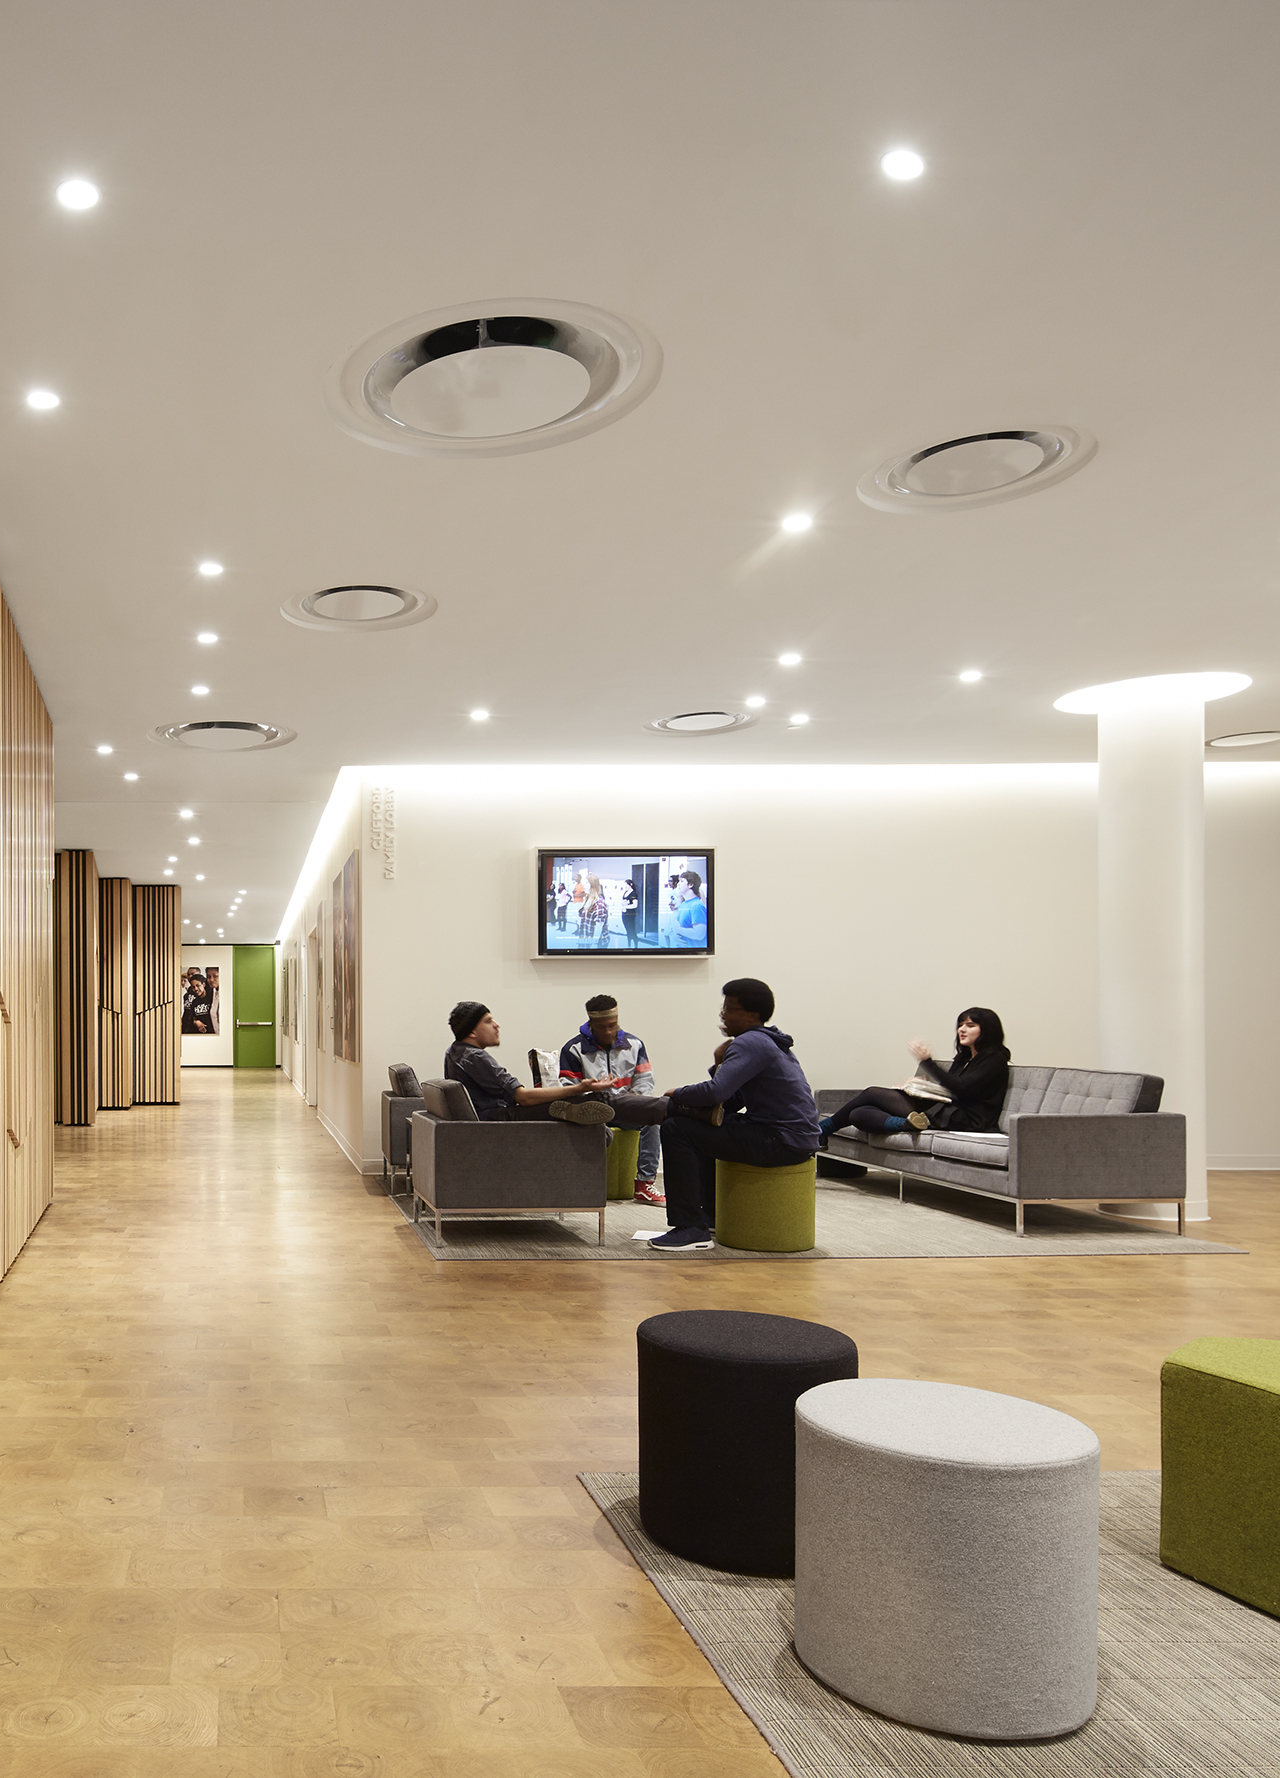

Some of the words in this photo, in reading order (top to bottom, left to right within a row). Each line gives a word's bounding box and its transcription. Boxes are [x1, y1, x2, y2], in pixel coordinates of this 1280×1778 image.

[370, 786, 381, 851] CLIFFORD
[383, 786, 395, 829] LOBBY
[383, 833, 395, 880] FAMILY
